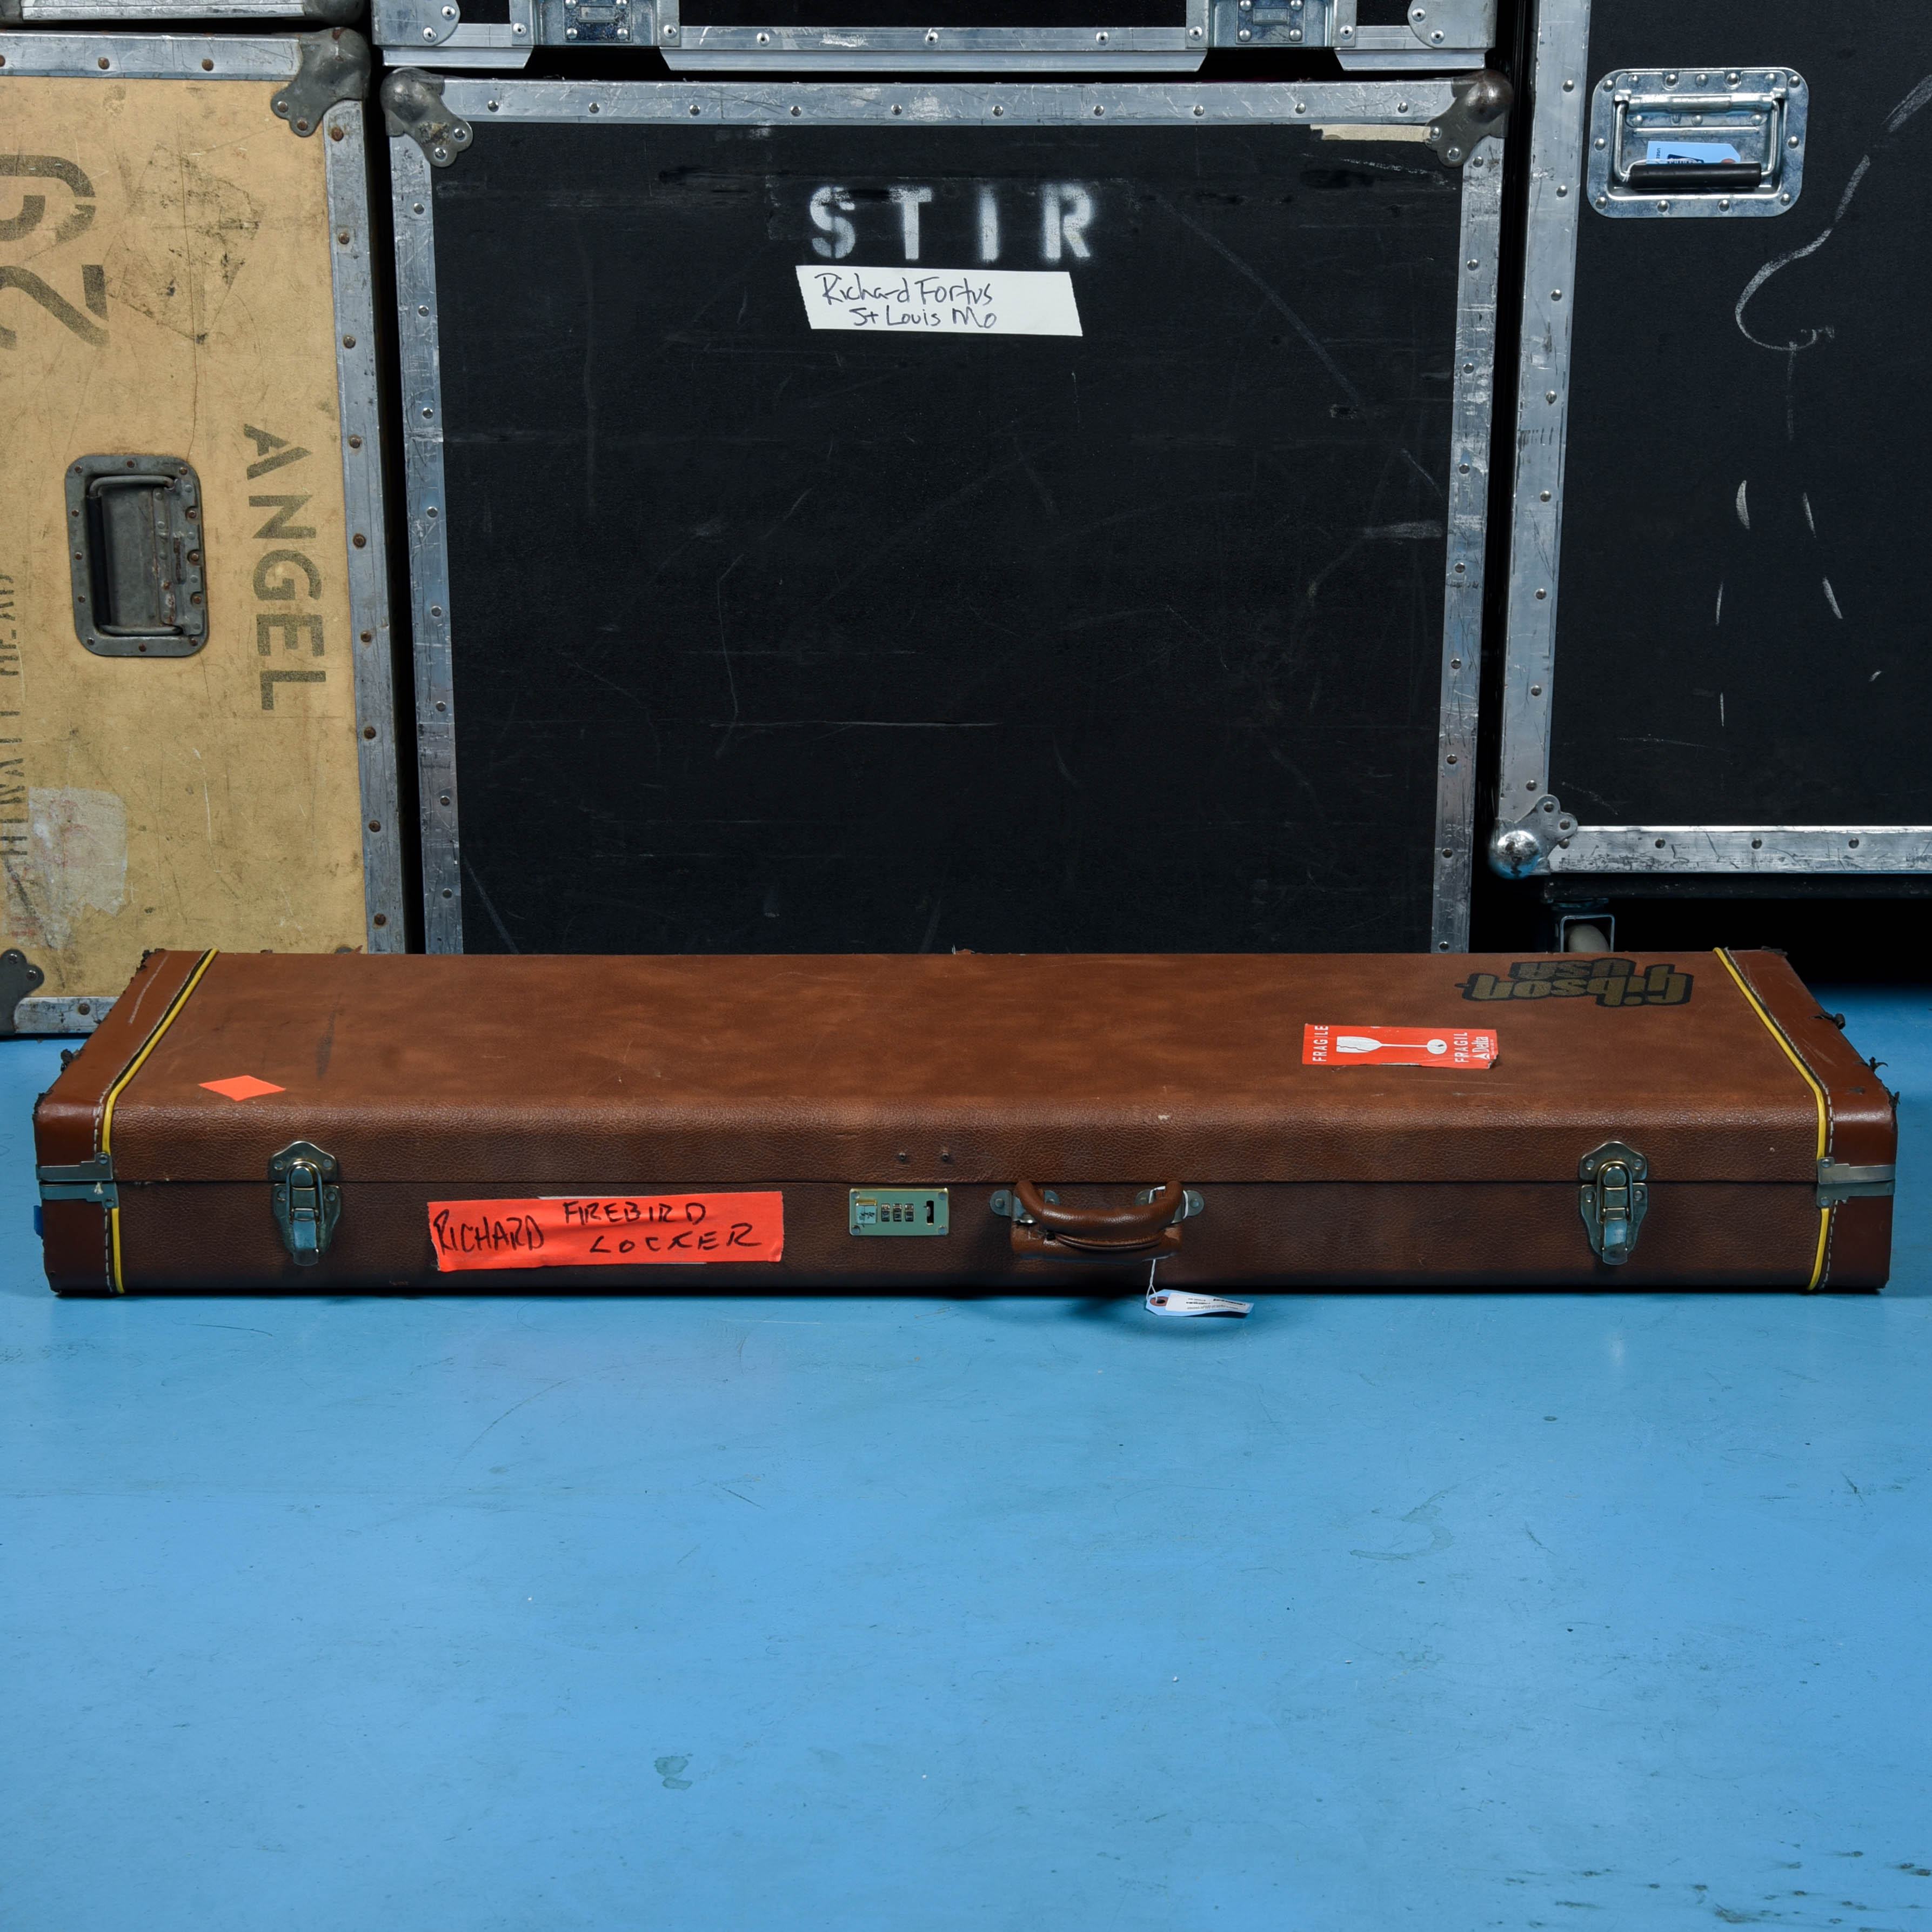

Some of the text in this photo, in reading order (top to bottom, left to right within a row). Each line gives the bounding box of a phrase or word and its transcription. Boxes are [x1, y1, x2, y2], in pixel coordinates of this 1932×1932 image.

[810, 184, 1094, 260] STIR
[814, 273, 910, 305] Richard
[849, 306, 878, 326] St
[886, 305, 941, 326] Louis
[244, 424, 326, 710] ANGEL
[1509, 958, 1636, 979] USA
[1462, 964, 1694, 1007] Gibson
[1312, 1025, 1329, 1062] FRAGILE
[1453, 1032, 1469, 1063] FRAGIL
[1472, 1036, 1489, 1055] Delta
[563, 1201, 706, 1225] FIREBIRD
[433, 1209, 545, 1255] RICHARD
[589, 1223, 762, 1254] LOCKER
